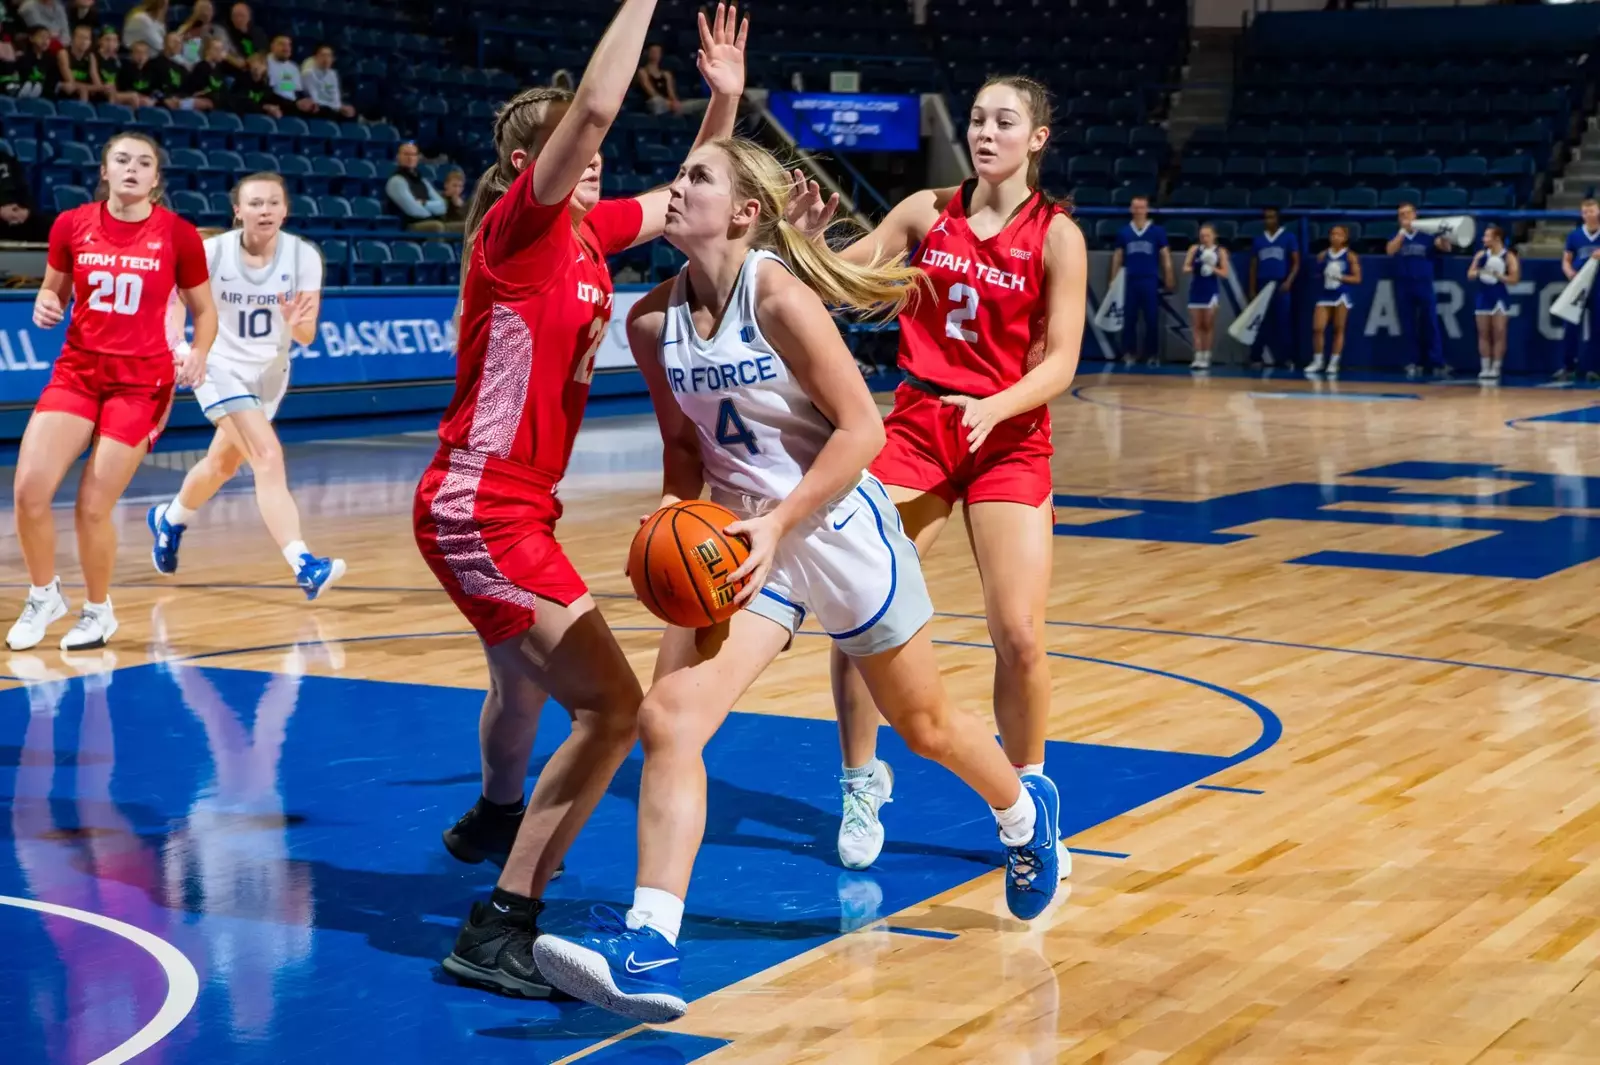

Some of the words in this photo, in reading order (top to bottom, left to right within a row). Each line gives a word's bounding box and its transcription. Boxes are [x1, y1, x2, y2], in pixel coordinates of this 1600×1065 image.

[78, 252, 117, 267] UTAH
[120, 255, 160, 271] TECH
[921, 248, 971, 274] UTAH
[975, 262, 1026, 292] TECH
[87, 270, 143, 315] 20
[221, 291, 243, 304] AIR
[944, 282, 980, 344] 2
[238, 307, 273, 339] 10
[0, 329, 50, 371] LL
[691, 355, 778, 392] FORCE
[715, 396, 760, 456] 4
